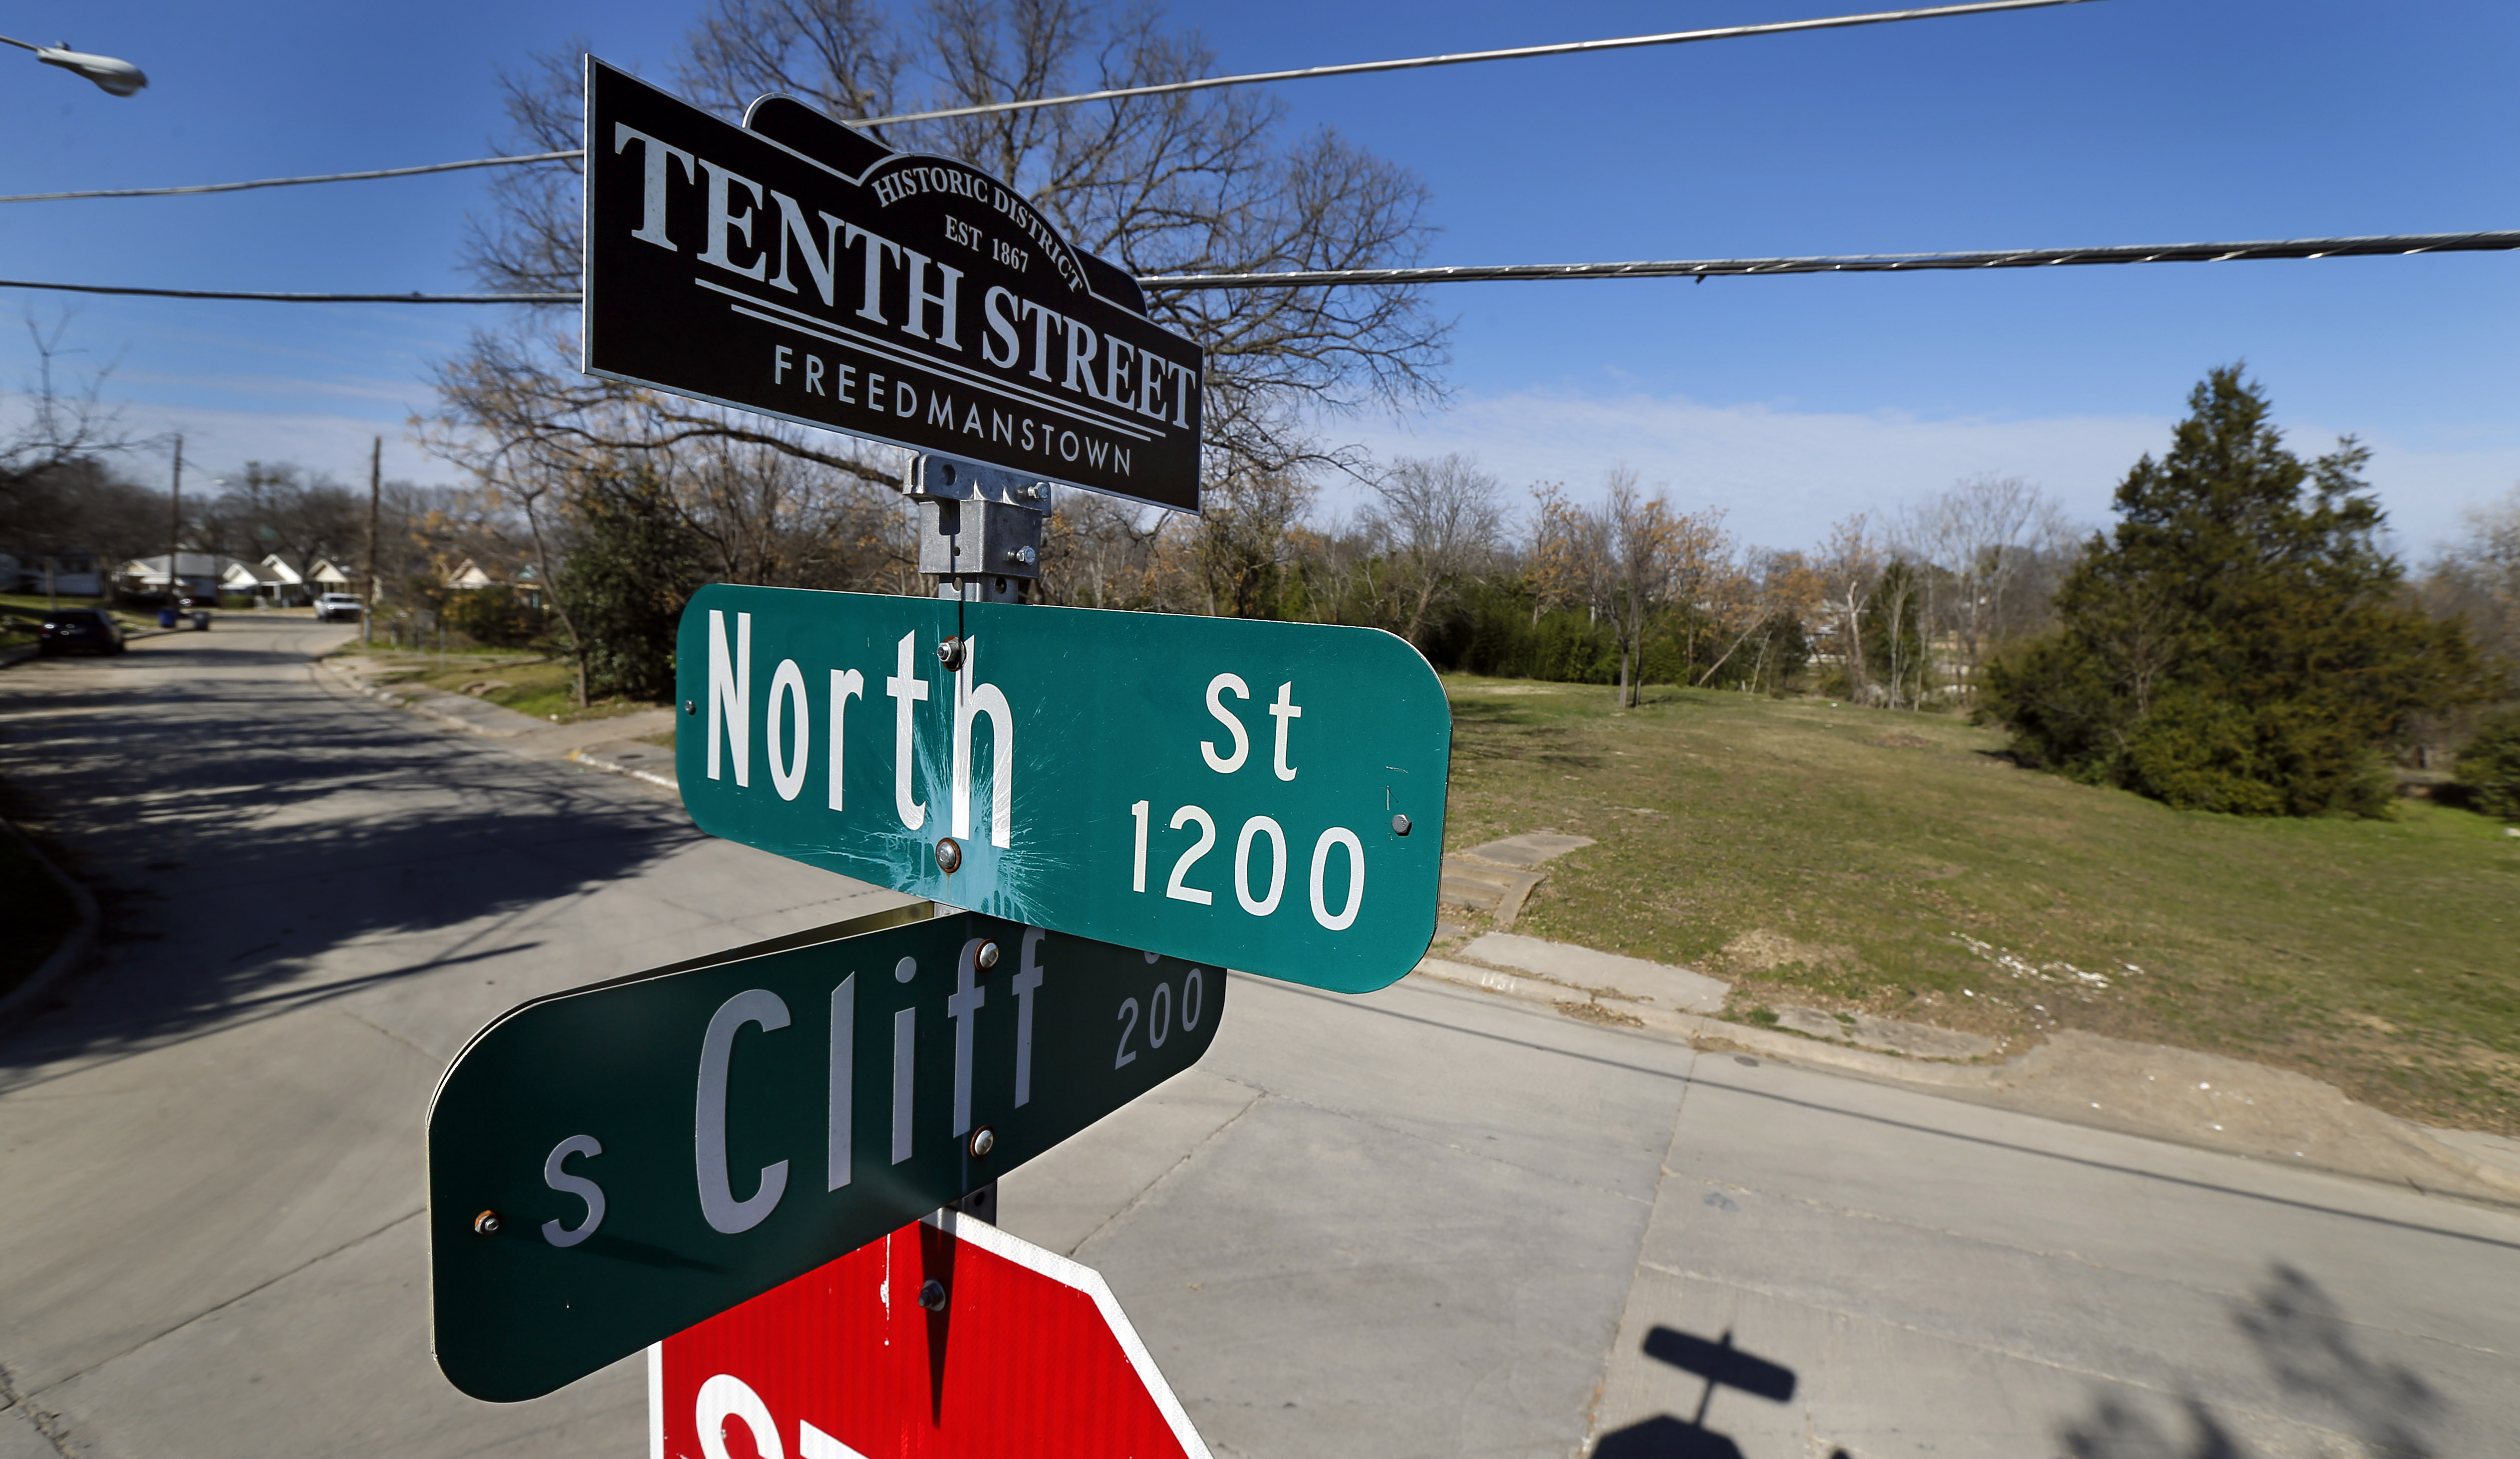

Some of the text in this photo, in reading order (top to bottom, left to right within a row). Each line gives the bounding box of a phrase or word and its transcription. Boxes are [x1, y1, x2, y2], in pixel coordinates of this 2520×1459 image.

[615, 121, 1196, 430] TENTH STREET
[871, 167, 1083, 292] HISTORIC DISTRICT
[945, 214, 1028, 273] EST 1867
[775, 344, 1130, 477] FREEDMANSTOWN
[708, 610, 1302, 849] North St
[1131, 800, 1366, 932] 1200
[1115, 968, 1203, 1070] 200
[542, 926, 1046, 1247] S Cliff
